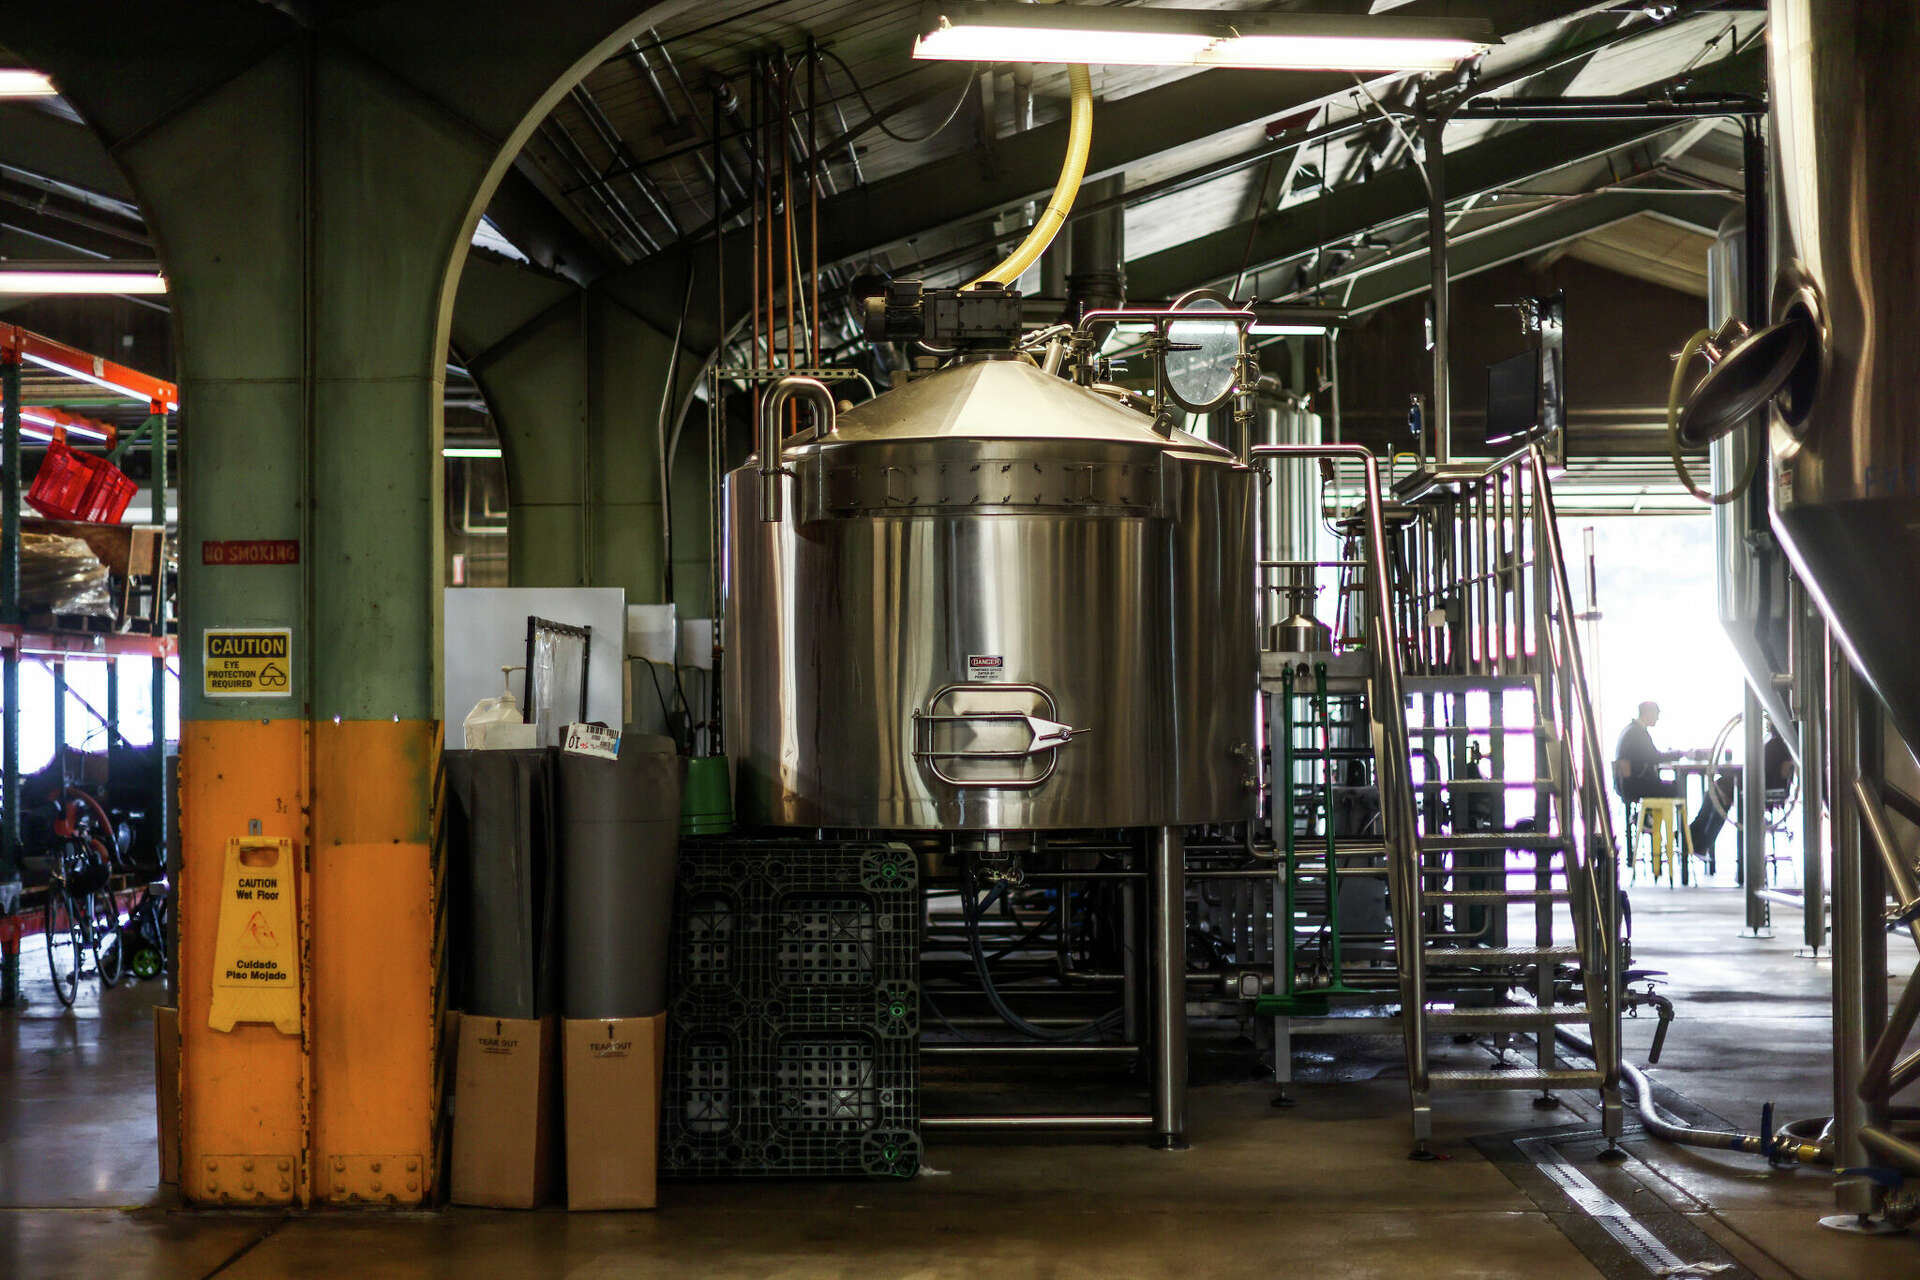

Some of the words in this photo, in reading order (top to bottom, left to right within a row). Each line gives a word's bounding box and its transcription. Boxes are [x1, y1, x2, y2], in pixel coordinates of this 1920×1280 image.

[204, 545, 224, 563] NO
[229, 545, 296, 561] SMOKING
[211, 638, 284, 655] CAUTION
[224, 661, 240, 669] EYE
[207, 670, 257, 679] PROTECTION
[211, 679, 253, 689] REQUIRED
[238, 879, 278, 888] CAUTION
[236, 889, 253, 900] Wet
[256, 889, 279, 900] Floor
[236, 960, 278, 969] Cuidado
[226, 971, 248, 980] Piso
[250, 971, 287, 981] Mojado
